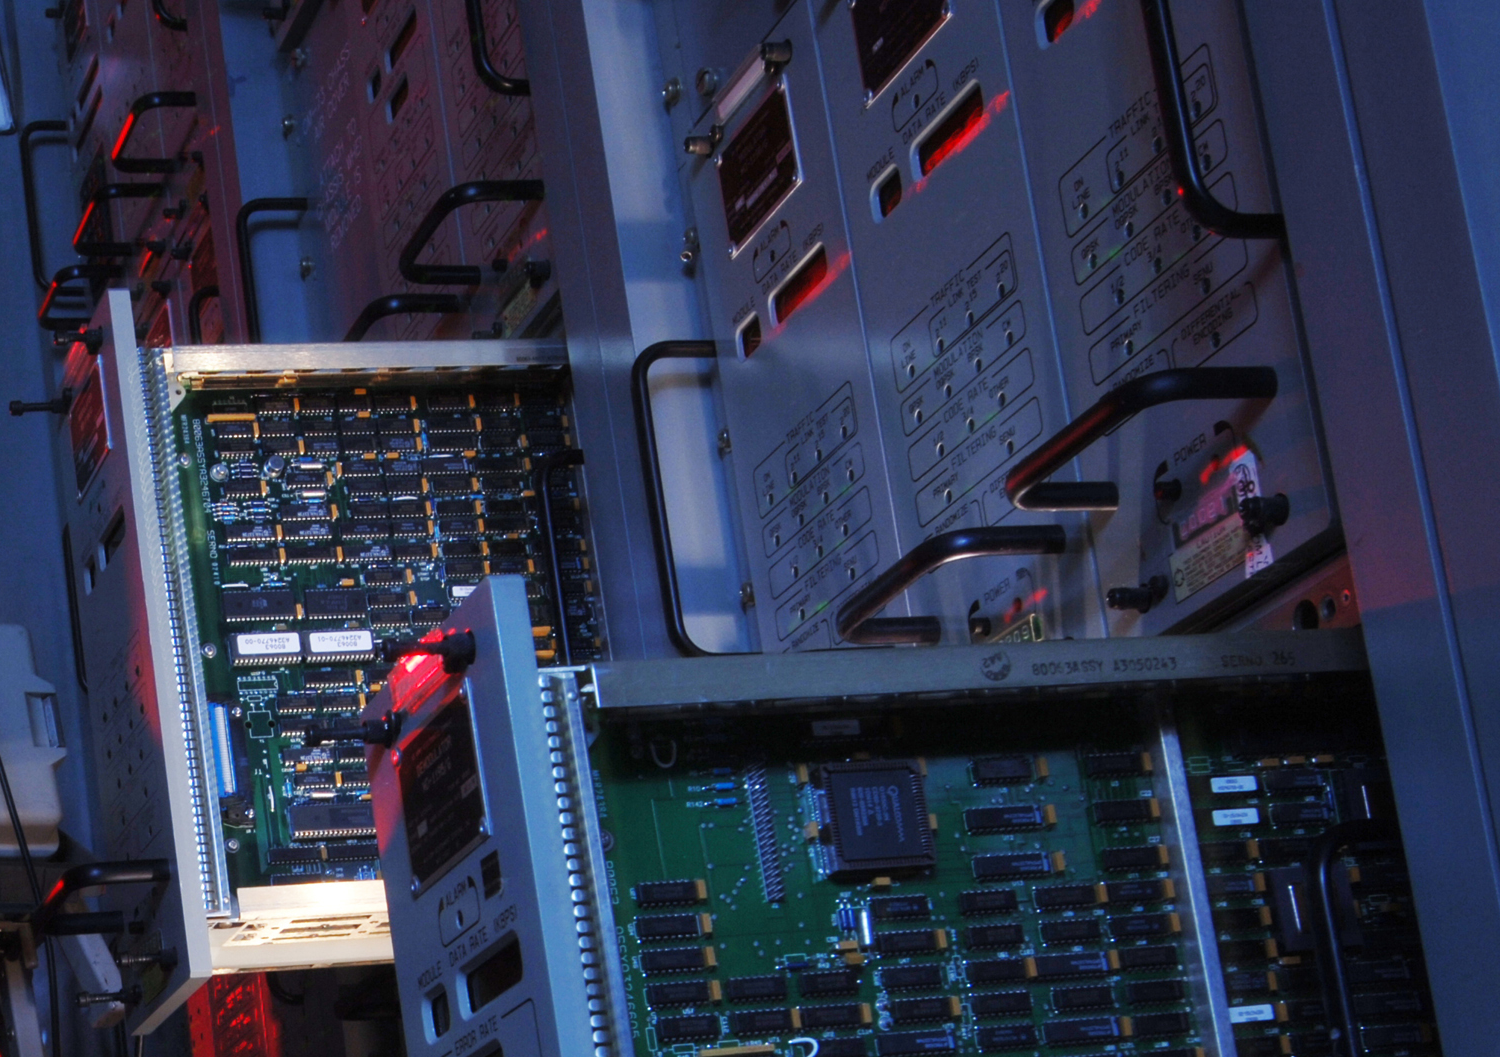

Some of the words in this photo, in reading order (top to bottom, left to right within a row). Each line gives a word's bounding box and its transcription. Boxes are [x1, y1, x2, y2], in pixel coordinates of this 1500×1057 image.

[901, 65, 925, 96] ALARM
[902, 118, 923, 145] DATA
[925, 91, 946, 120] RATE
[952, 56, 980, 92] (KBPS)
[1107, 90, 1152, 138] TRAFFIC
[1129, 112, 1150, 136] LINK
[866, 146, 895, 183] MODULE
[1072, 186, 1091, 210] LINE
[1073, 176, 1084, 192] ON
[1111, 157, 1171, 217] MODULATIO
[760, 226, 780, 249] ALARM
[1123, 235, 1150, 267] CODE
[1153, 209, 1180, 239] RATE
[762, 274, 780, 295] DATA
[780, 250, 798, 272] RATE
[930, 269, 965, 307] TRAFFIC
[947, 287, 964, 308] LINK
[966, 269, 982, 289] TEST
[1133, 262, 1191, 318] FILTERING
[732, 296, 756, 326] MODULE
[1180, 288, 1242, 340] DIFFERENTIAL
[1192, 307, 1234, 346] ENCODING
[902, 339, 911, 352] ON
[1109, 320, 1142, 351] PRIMARY
[901, 349, 916, 369] LINE
[933, 327, 984, 378] MODULATION
[943, 397, 965, 424] CODE
[967, 376, 990, 403] RATE
[988, 375, 1009, 399] OTHER
[786, 411, 814, 443] TRAFFIC
[816, 412, 828, 430] TEST
[950, 425, 997, 470] FILTERING
[1173, 433, 1206, 466] POWER
[789, 464, 831, 507] MODULATION
[932, 472, 959, 498] PRIMARY
[798, 526, 816, 549] CODE
[817, 509, 835, 531] RATE
[834, 509, 852, 530] OTHER
[935, 504, 969, 535] RANDOMIZE
[206, 529, 218, 559] SERNO
[804, 553, 842, 592] FILTERING
[984, 577, 1010, 605] POWER
[1220, 654, 1263, 668] SERNO
[444, 879, 467, 910] ALARM
[450, 943, 467, 968] DATA
[468, 926, 489, 950] RATE
[492, 903, 518, 933] (KBPS)
[417, 960, 443, 989] MODULE
[454, 1029, 477, 1056] ERROR
[479, 1015, 499, 1041] RATE
